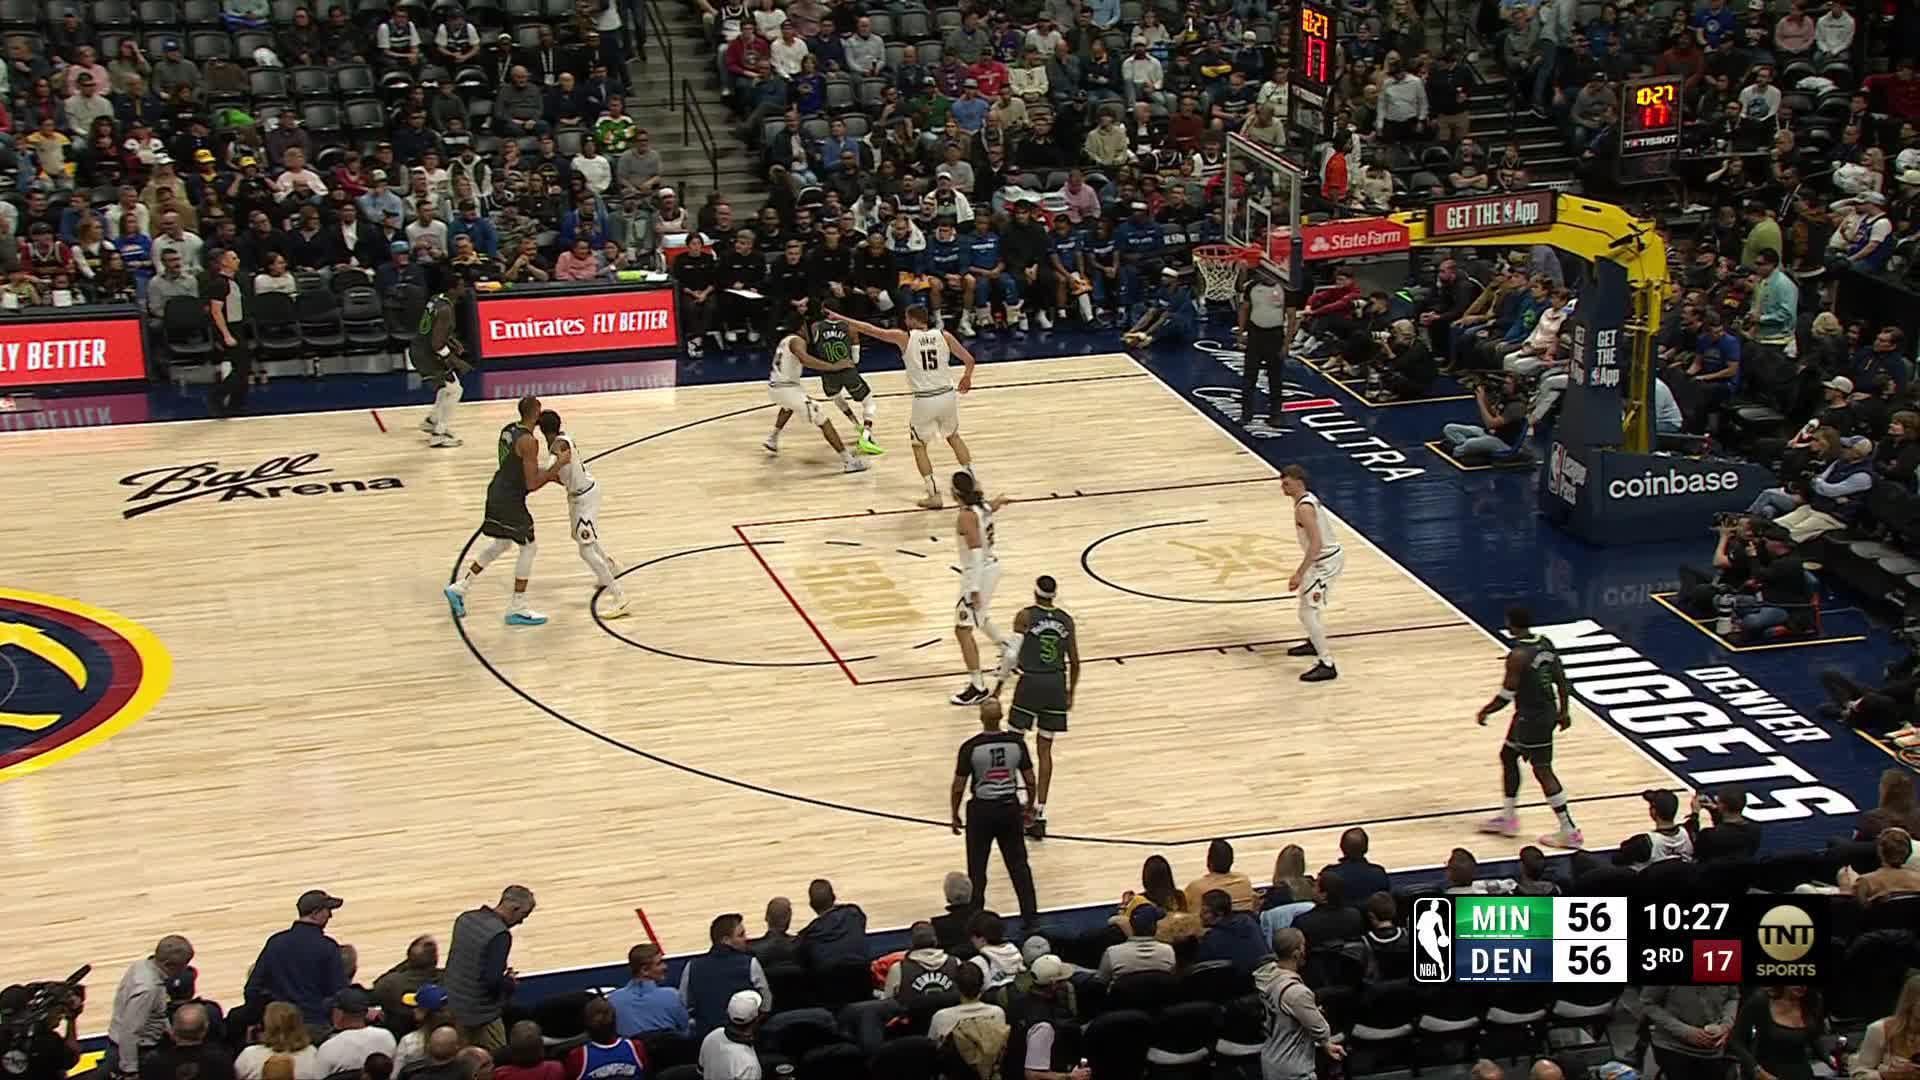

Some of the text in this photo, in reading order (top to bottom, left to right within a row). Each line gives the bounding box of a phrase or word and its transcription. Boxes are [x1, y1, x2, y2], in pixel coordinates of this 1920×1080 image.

[1645, 104, 1666, 127] 17
[1447, 199, 1539, 229] GET THE App
[489, 309, 669, 341] Emirates FLY BETTER
[1597, 329, 1618, 347] GET
[27, 338, 107, 371] BETTER
[823, 341, 848, 362] 10
[920, 349, 938, 371] 15
[1596, 347, 1617, 365] THE
[1600, 367, 1620, 387] App
[1301, 411, 1427, 483] ULTRA
[119, 453, 334, 505] Ball
[218, 476, 405, 502] Arena
[1608, 468, 1739, 498] coinbase
[1040, 635, 1057, 663] 3
[1683, 665, 1832, 743] DENVER
[1499, 618, 1860, 823] NUGGETS
[990, 747, 1006, 767] 12
